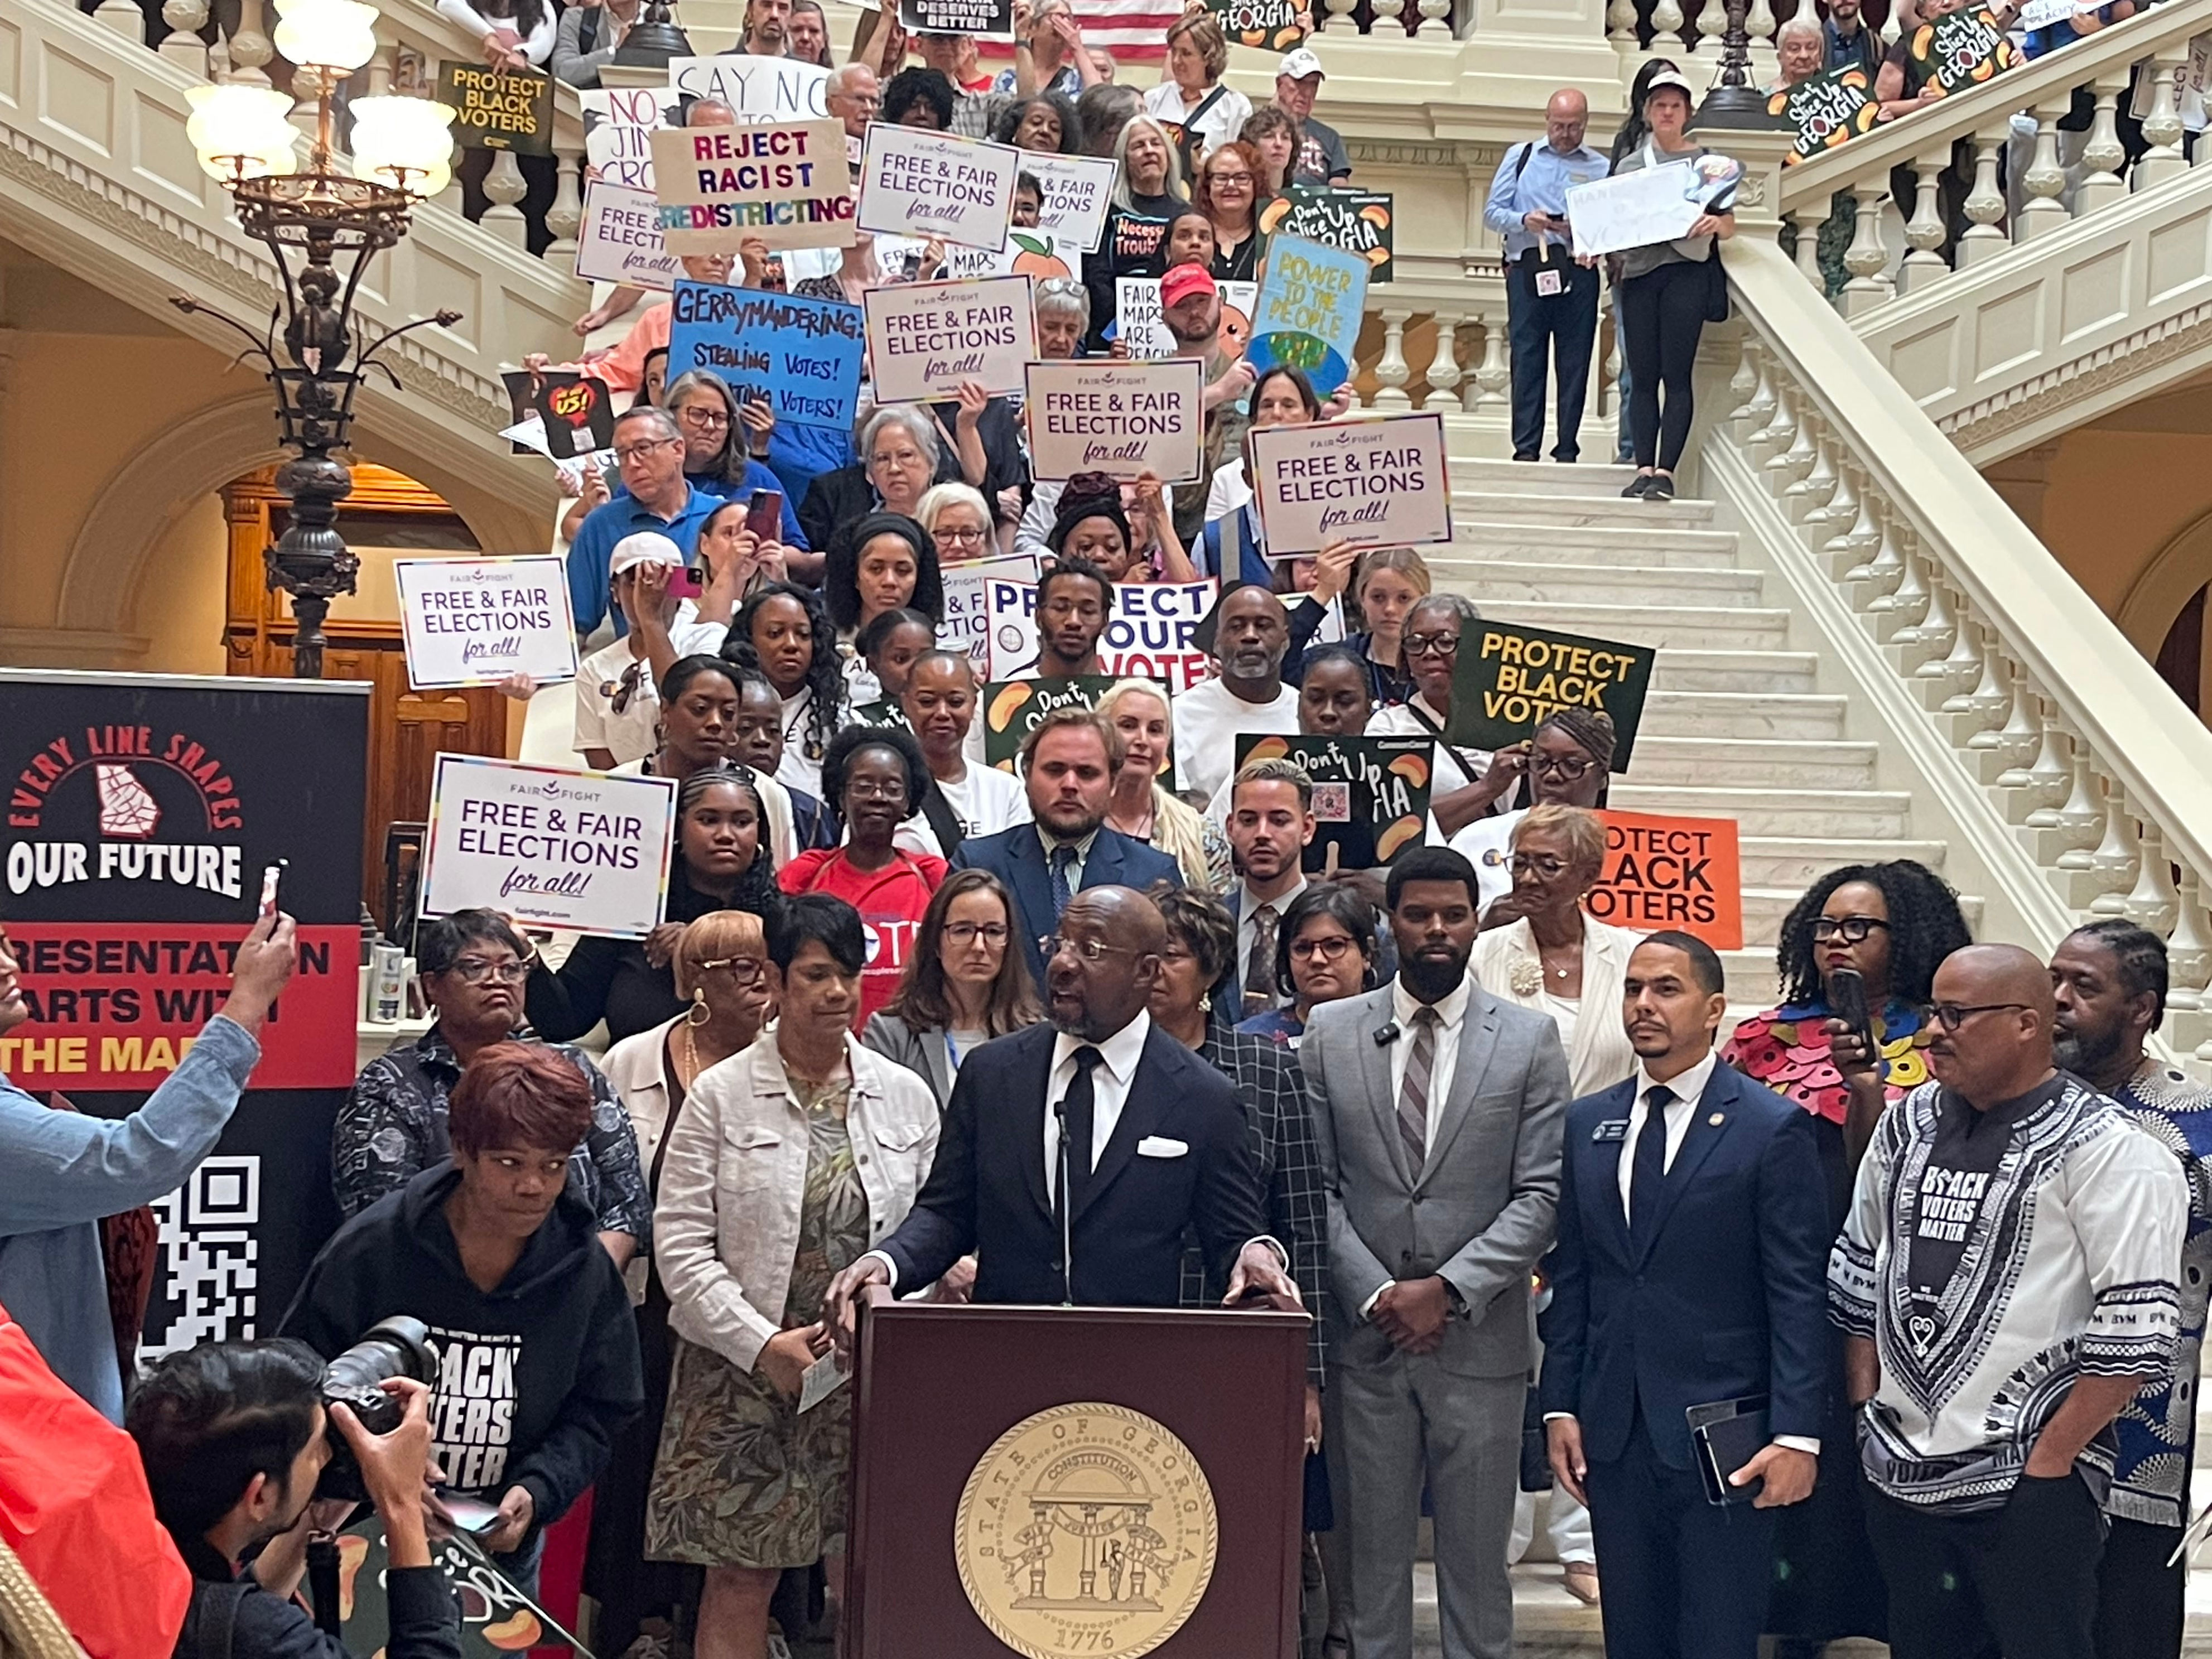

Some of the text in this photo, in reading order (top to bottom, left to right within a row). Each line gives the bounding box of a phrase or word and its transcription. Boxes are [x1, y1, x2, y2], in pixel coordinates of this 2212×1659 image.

[917, 1, 999, 18] DESERVES
[927, 15, 988, 30] BETTER
[1216, 2, 1295, 30] GEORGIA
[1937, 23, 2001, 88] GEORGIA
[454, 69, 546, 98] PROTECT
[678, 66, 755, 116] SAY
[466, 90, 532, 115] BLACK
[609, 90, 656, 124] NO
[1789, 98, 1823, 126] Slice
[458, 107, 537, 134] VOTERS
[1793, 86, 1867, 155] GEORGIA
[693, 131, 808, 161] REJECT
[698, 162, 814, 194] RACIST
[883, 153, 997, 187] FREE & FAIR
[880, 172, 995, 207] ELECTIONS
[1044, 178, 1095, 196] & FAIR
[601, 207, 663, 231] FREE &
[659, 195, 857, 230] REDISTRICTING
[906, 198, 966, 223] for all!
[1328, 204, 1355, 232] Up
[599, 224, 664, 250] ELECTI
[622, 250, 646, 269] for
[954, 252, 996, 271] MAPS
[1278, 251, 1352, 293] POWER
[914, 292, 979, 306] FAIR FIGHT
[1124, 285, 1158, 304] FAIR
[1285, 280, 1337, 313] TO THE
[885, 306, 1013, 333] FREE & FAIR
[1269, 297, 1343, 339] PEOPLE
[888, 326, 1015, 355] ELECTIONS
[1125, 327, 1154, 345] ARE
[784, 352, 841, 381] VOTES!
[923, 353, 985, 382] for all!
[780, 389, 843, 419] VOTERS!
[1047, 392, 1180, 412] FREE & FAIR
[1048, 414, 1182, 435] ELECTIONS
[1083, 440, 1148, 465] for all!
[1310, 434, 1384, 448] FAIR FIGHT
[1276, 448, 1422, 479] FREE & FAIR
[1279, 471, 1424, 503] ELECTIONS
[1319, 499, 1390, 533] for all!
[953, 577, 982, 586] FIGHT
[421, 589, 548, 610] FREE & FAIR
[948, 596, 965, 613] &
[995, 583, 1209, 618] PRECT
[424, 611, 551, 634] ELECTIONS
[1105, 620, 1198, 650] OUR
[462, 636, 522, 664] for all!
[1481, 632, 1636, 682] PROTECT
[1496, 664, 1607, 709] BLACK
[1483, 691, 1608, 726] VOT
[7, 725, 244, 830] EVERY LINE SHAPES
[1342, 752, 1382, 796] Up
[509, 784, 601, 803] FAIR FIGHT
[461, 799, 642, 841] FREE & FAIR
[458, 828, 639, 869] ELECTIONS
[1607, 826, 1712, 856] OTECT
[7, 841, 242, 900] OUR FUTURE
[500, 865, 592, 898] for all!
[1596, 853, 1714, 892] ACK
[1586, 888, 1715, 923] OTERS
[12, 939, 330, 975] RESENTATN
[22, 988, 141, 1023] ARTS
[0, 1037, 88, 1073] THE
[1921, 1195, 1977, 1223] VOTERS
[1918, 1218, 1967, 1242] MATTER
[440, 1342, 514, 1398] ACK
[427, 1394, 514, 1445] TERS
[429, 1443, 508, 1488] TTER
[1047, 1453, 1138, 1482] CONSTITUTION
[979, 1450, 1026, 1557] STATE
[1052, 1418, 1089, 1440] OF
[1122, 1425, 1202, 1562] GEORGIA
[1053, 1628, 1114, 1650] 1776
